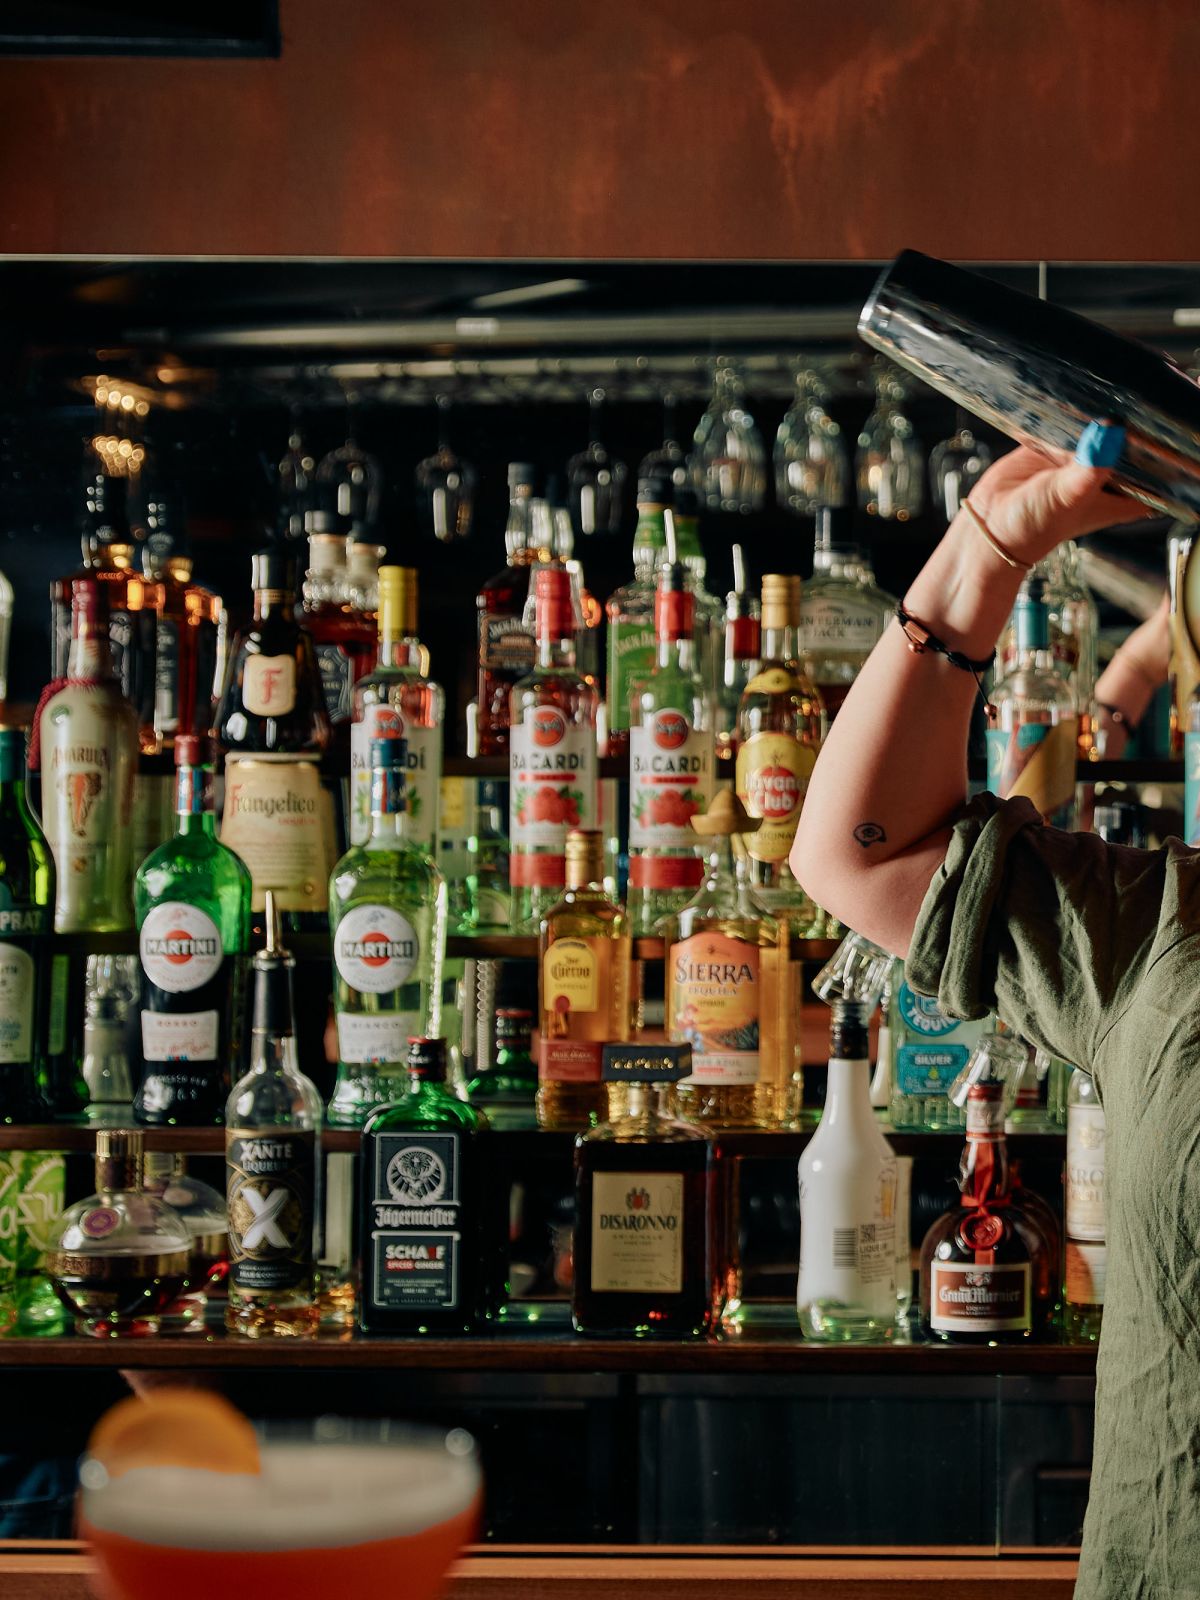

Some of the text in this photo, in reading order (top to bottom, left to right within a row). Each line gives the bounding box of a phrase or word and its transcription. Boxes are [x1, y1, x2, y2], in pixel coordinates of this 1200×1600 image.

[230, 783, 316, 819] Frangelico
[146, 938, 216, 956] MARTINI
[341, 941, 414, 959] MARTINI
[551, 960, 590, 981] Cuervo
[675, 955, 754, 985] SIERRA
[907, 1006, 957, 1031] TEQUIL
[914, 1053, 953, 1066] SILVER
[600, 1215, 677, 1232] DISARONNO
